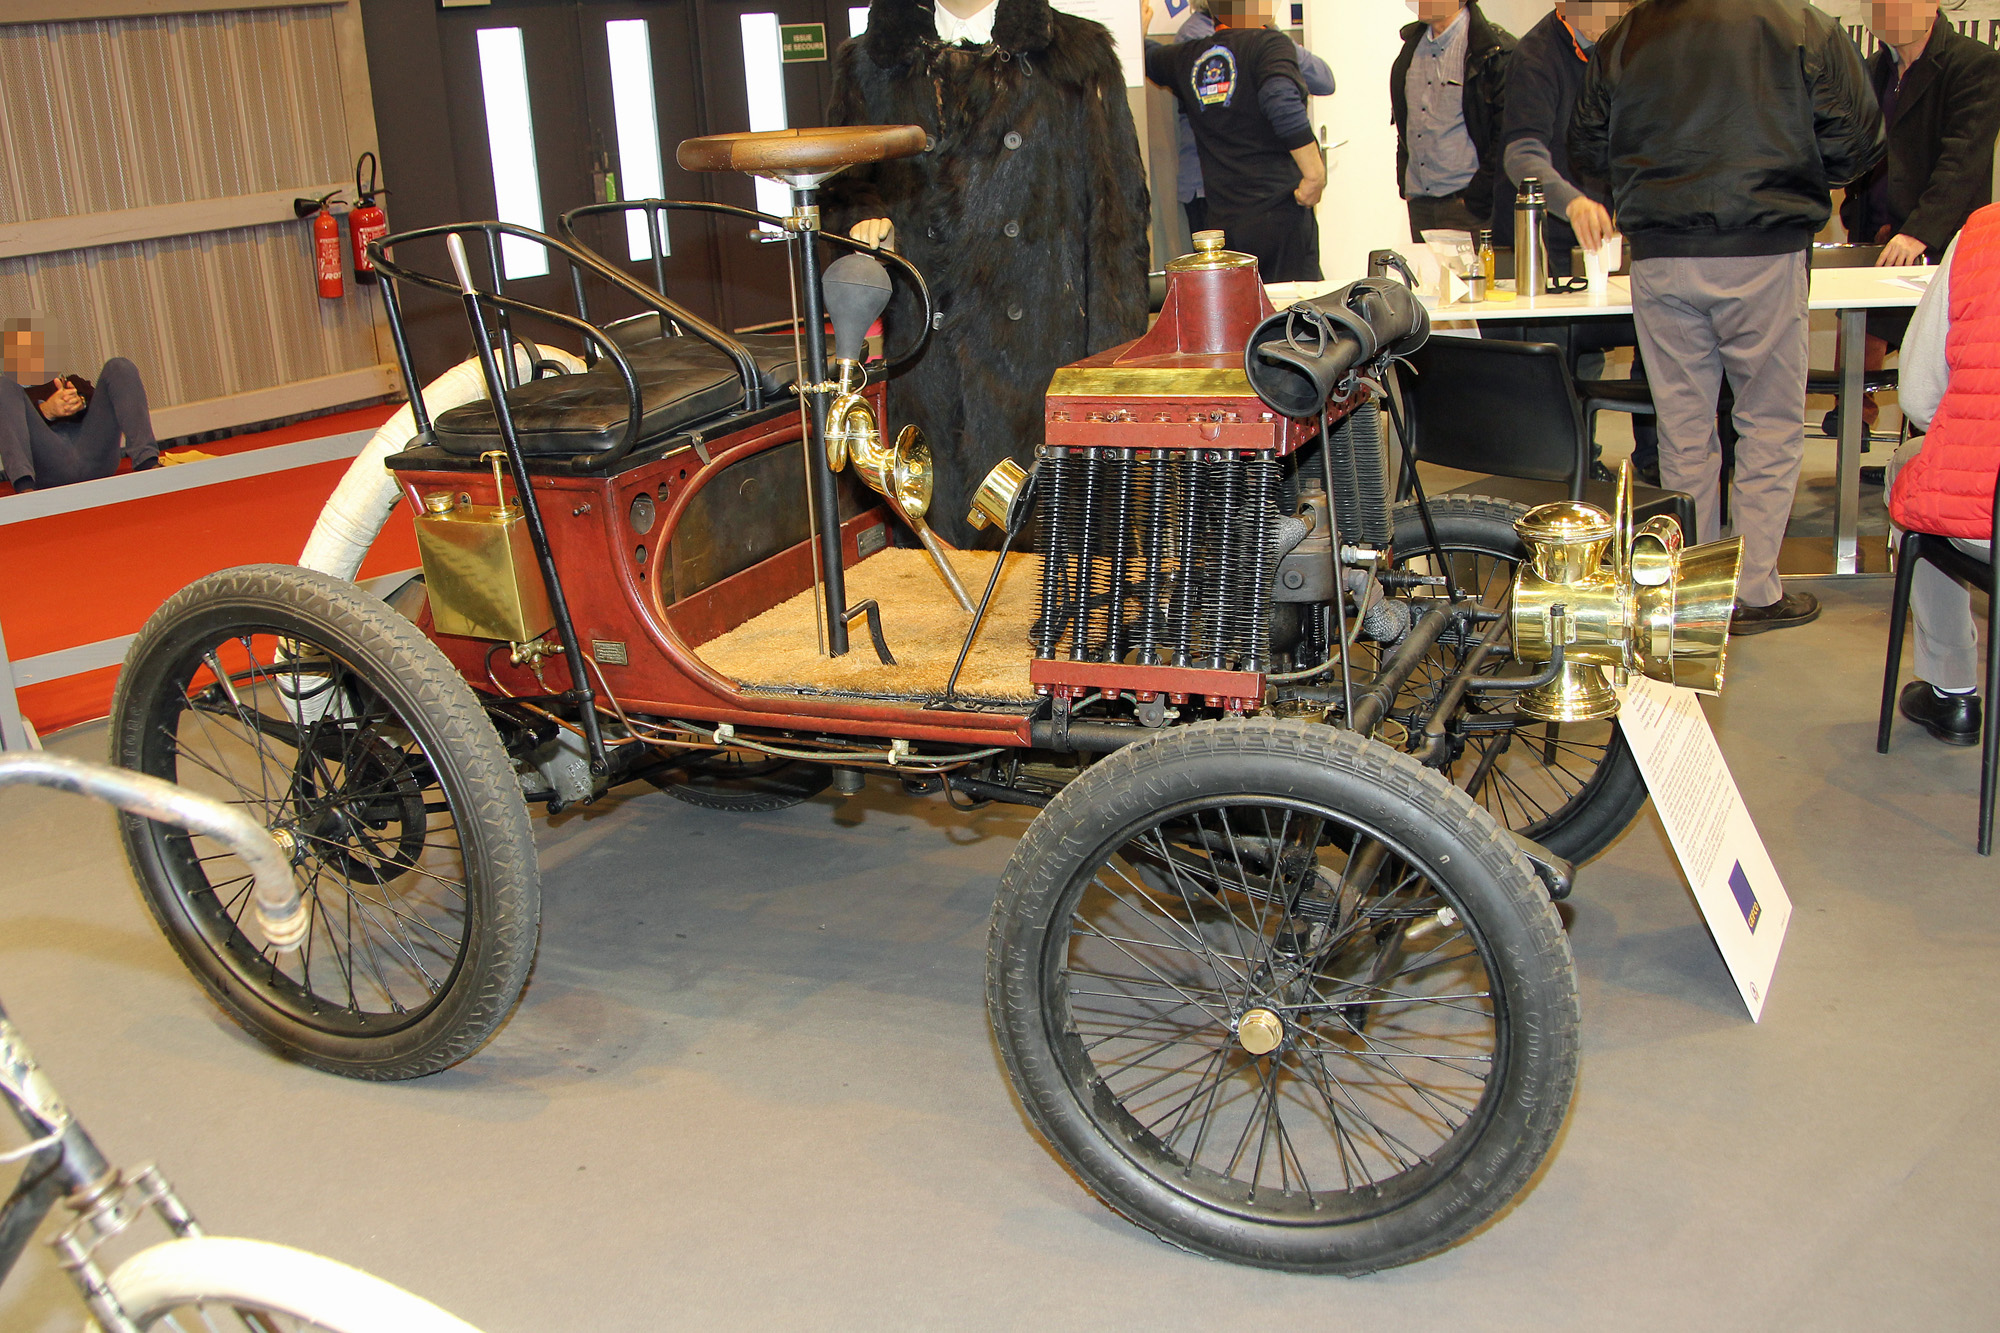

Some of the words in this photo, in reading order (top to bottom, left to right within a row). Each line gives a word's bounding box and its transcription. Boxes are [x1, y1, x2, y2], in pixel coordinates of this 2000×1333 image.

[784, 43, 792, 52] DE
[793, 41, 824, 51] SECOURS
[793, 33, 812, 42] ISSUE
[1100, 772, 1199, 821] HEAVY
[1018, 833, 1085, 918] EXTRA
[1748, 901, 1760, 928] GEFCO
[1007, 948, 1068, 1124] MOTORCYCLE
[1079, 1146, 1145, 1204] CORD
[1168, 1212, 1285, 1260] DUNLOP
